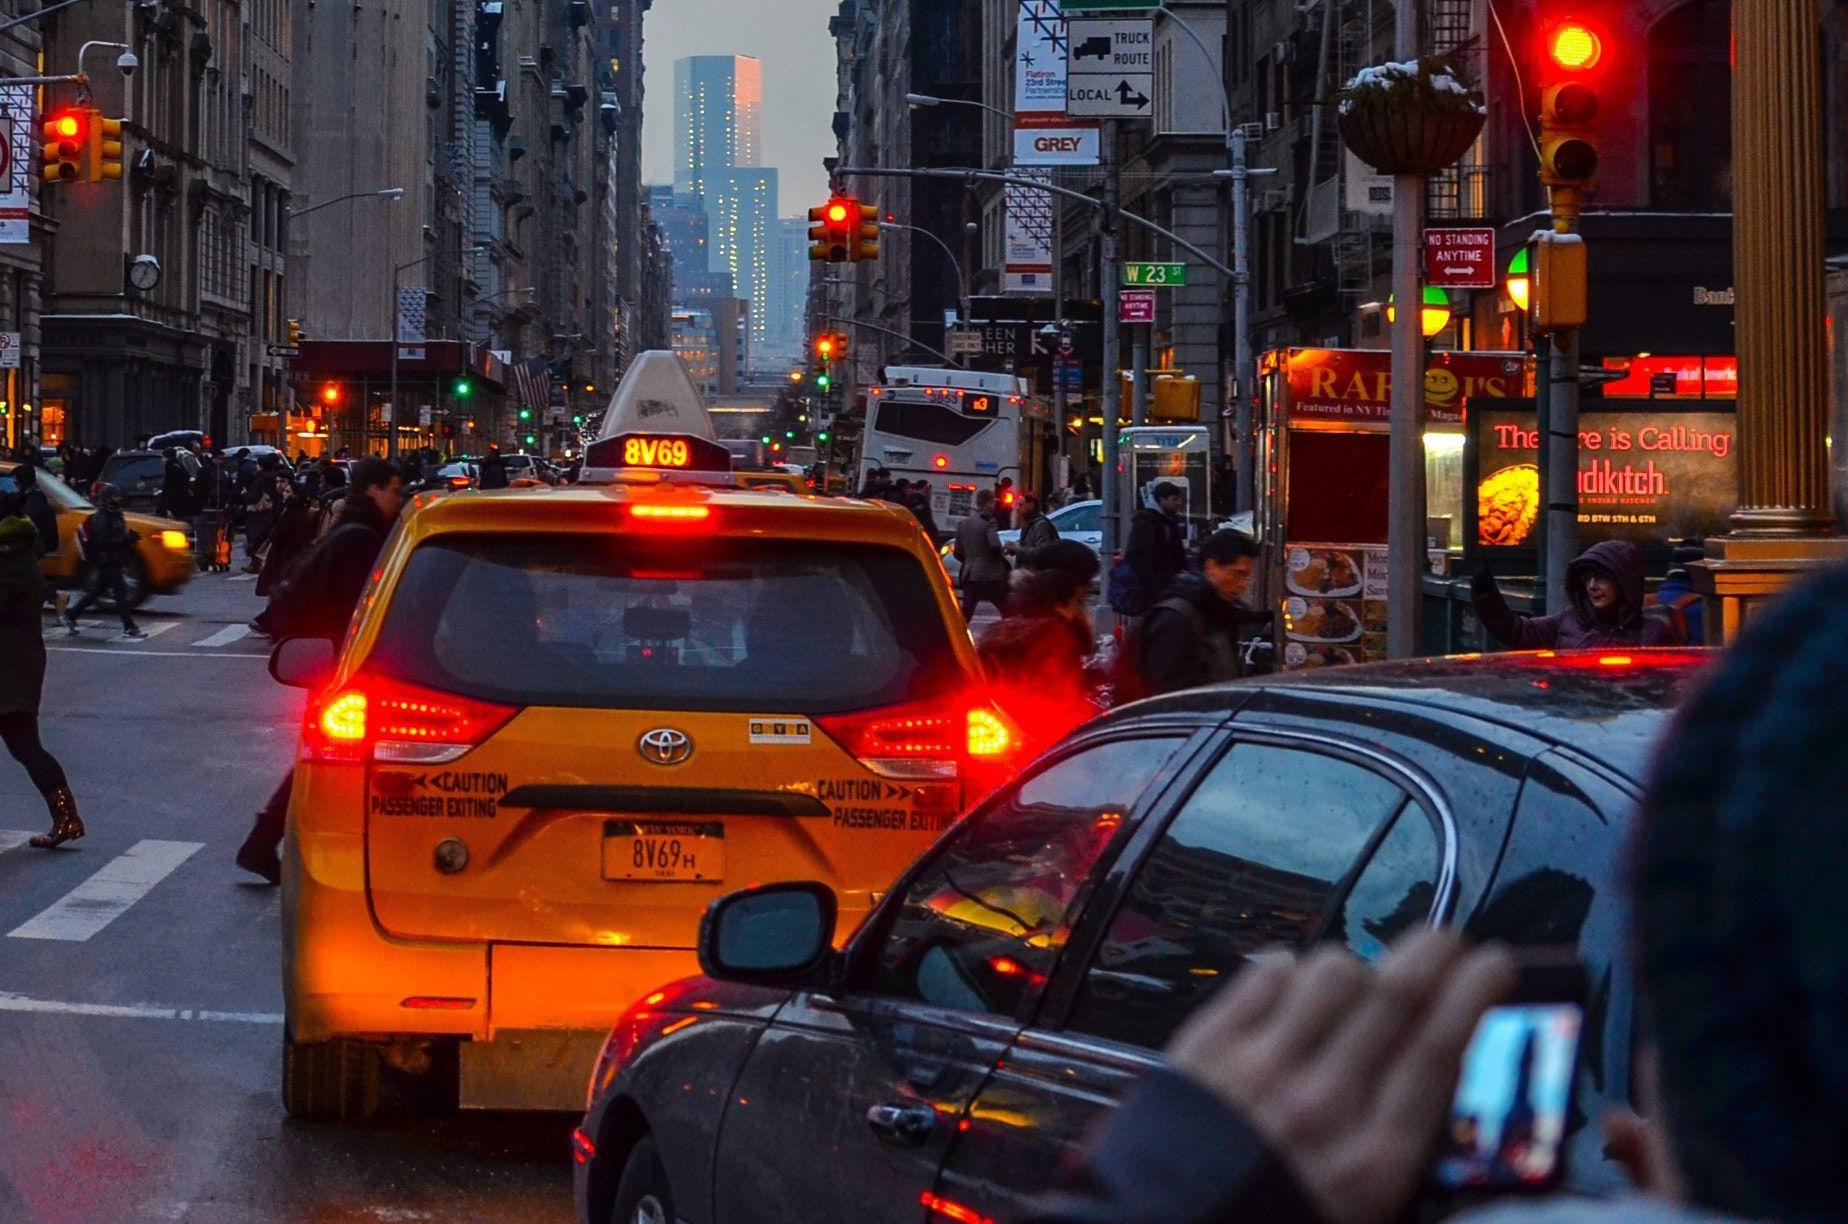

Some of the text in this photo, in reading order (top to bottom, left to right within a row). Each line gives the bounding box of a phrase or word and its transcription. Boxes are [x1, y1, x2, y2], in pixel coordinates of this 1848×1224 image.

[1115, 32, 1150, 45] TRUCK
[1114, 53, 1150, 66] ROUTE
[1025, 70, 1056, 78] Flatiron
[1069, 88, 1112, 101] LOCAL
[1033, 136, 1082, 152] GREY
[1428, 233, 1490, 246] NO STANDING
[1435, 249, 1483, 262] ANYTIME
[1126, 265, 1140, 282] W
[1146, 265, 1166, 283] 23
[1296, 402, 1341, 413] Featured
[1343, 404, 1353, 414] in
[1356, 406, 1371, 415] NY
[1494, 425, 1539, 449] The
[1609, 427, 1632, 450] is
[1638, 427, 1730, 458] Calling
[624, 438, 688, 466] 8V69
[1595, 514, 1611, 524] BTW
[442, 771, 509, 793] CAUTION
[817, 779, 881, 801] CAUTION
[371, 795, 497, 818] PASSENGER EXITING
[833, 807, 907, 829] PASSENGER
